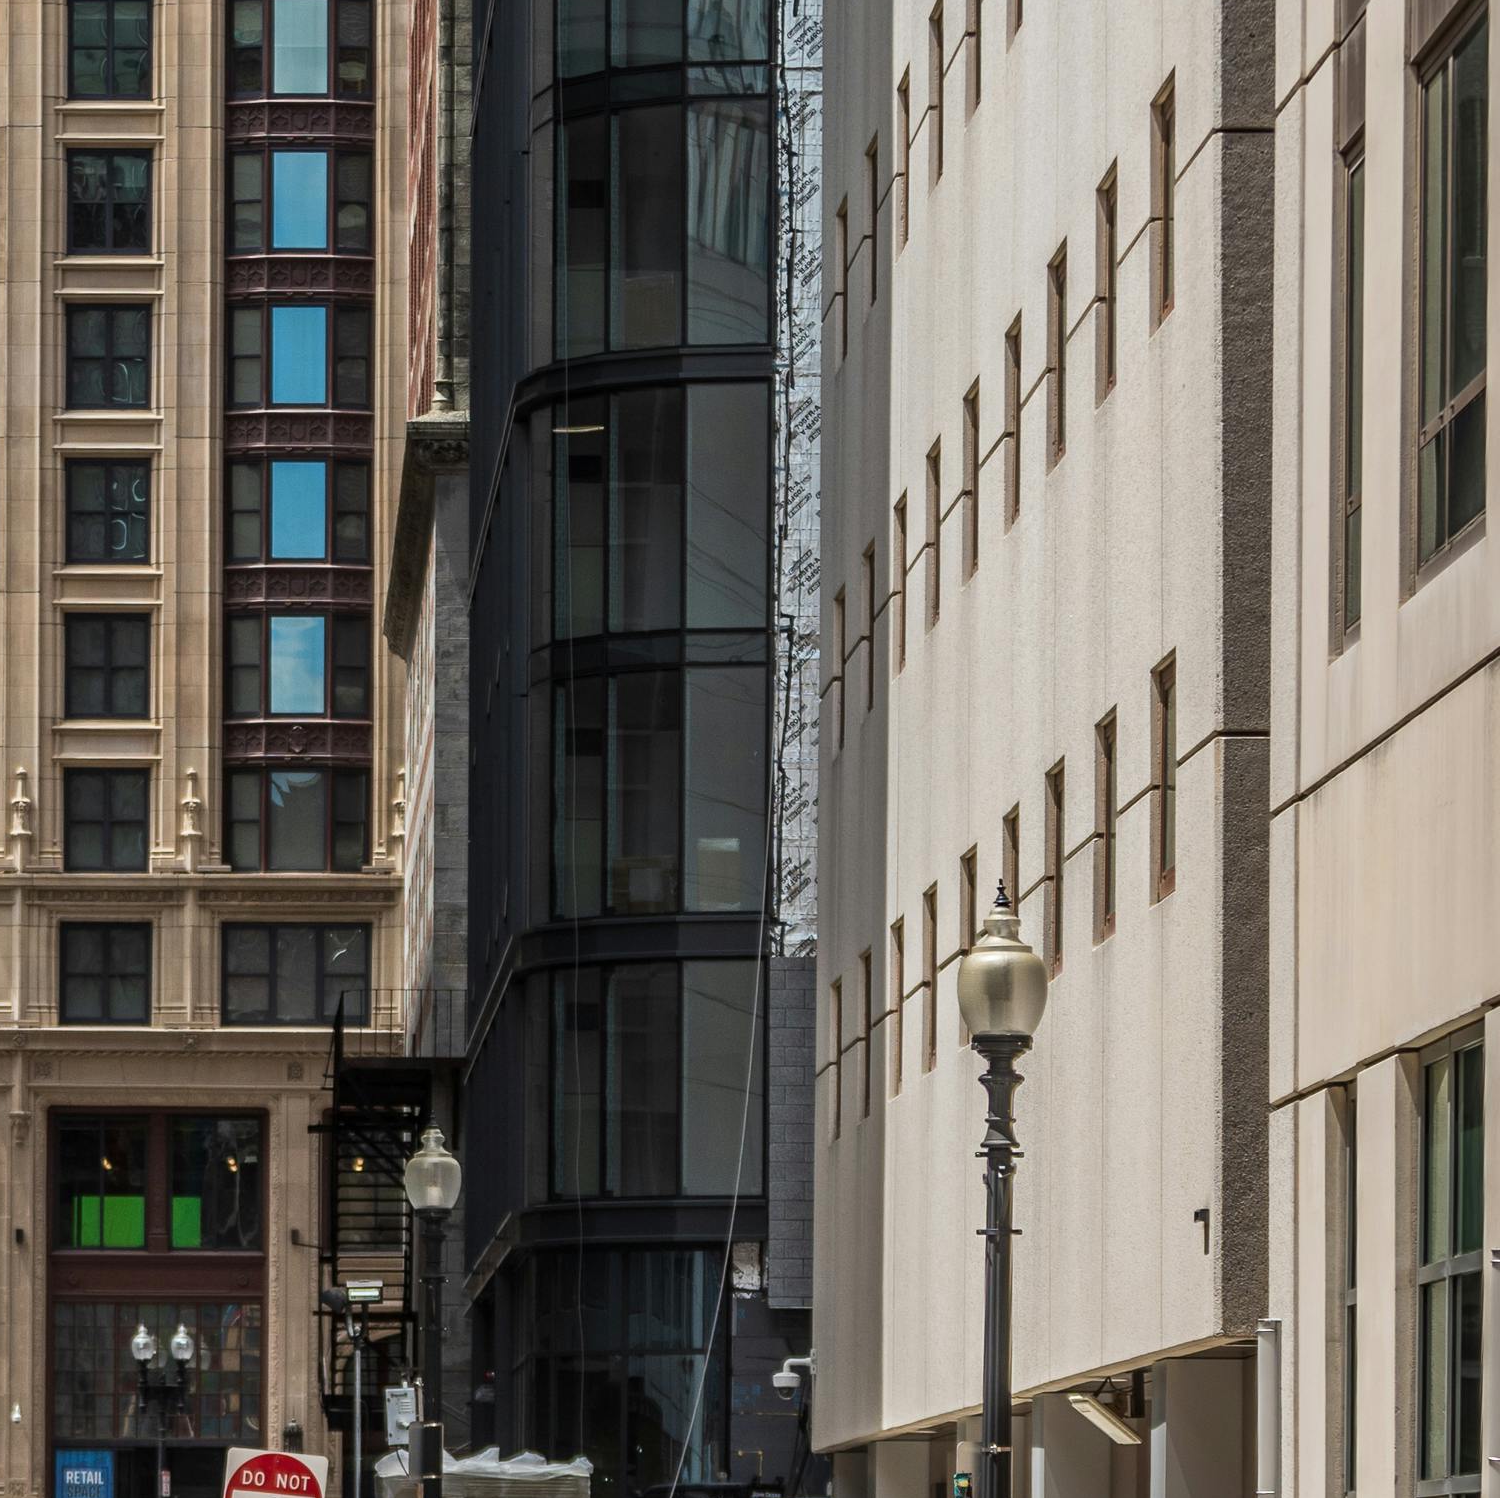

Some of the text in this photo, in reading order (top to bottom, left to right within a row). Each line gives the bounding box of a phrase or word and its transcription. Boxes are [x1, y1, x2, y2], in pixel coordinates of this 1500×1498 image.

[66, 1471, 104, 1484] RETAIL
[242, 1470, 311, 1491] DO NOT
[67, 1485, 102, 1498] SPACE
